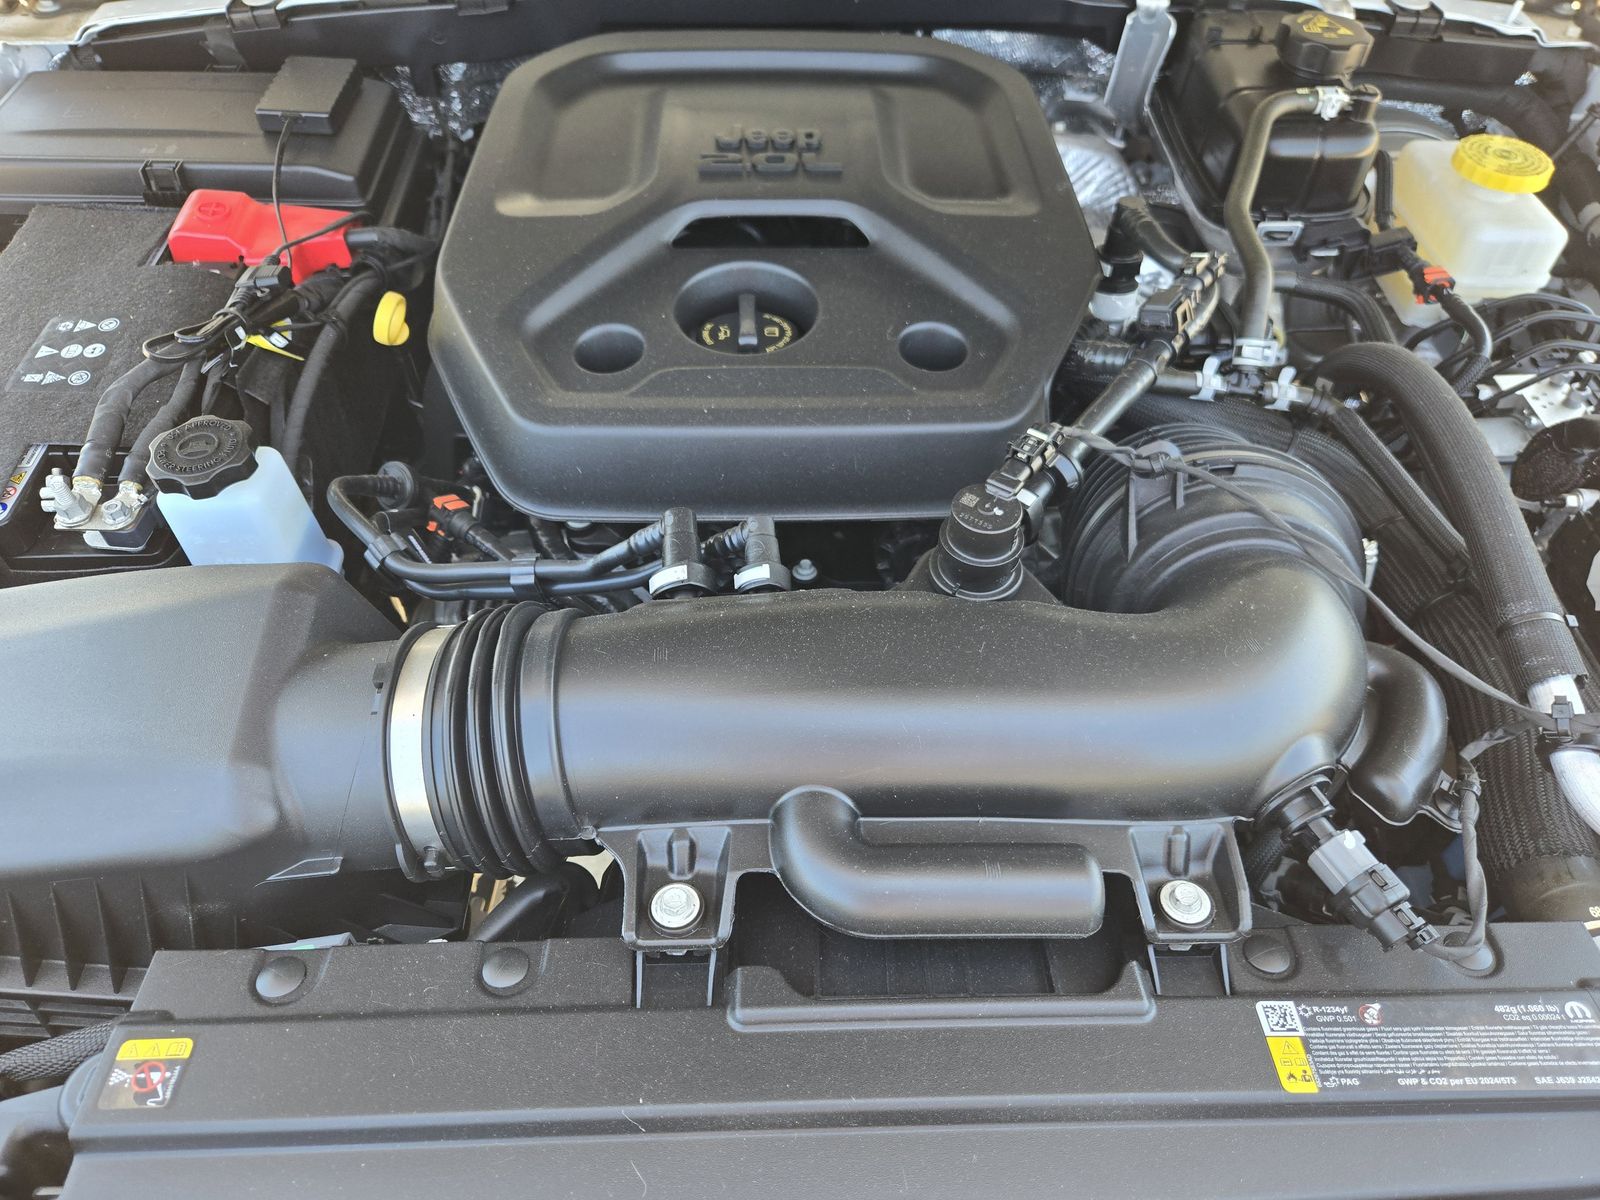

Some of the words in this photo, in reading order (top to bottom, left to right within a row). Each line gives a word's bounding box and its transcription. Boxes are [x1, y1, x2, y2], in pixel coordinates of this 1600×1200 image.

[698, 152, 844, 177] 2.0L
[184, 419, 233, 431] APPROVED
[176, 454, 224, 473] STEERING
[1312, 1005, 1348, 1015] R-1234yf
[1494, 1004, 1517, 1014] 482g
[1336, 1015, 1357, 1023] 0.501
[1502, 1013, 1520, 1021] CO2
[1521, 1014, 1532, 1022] eq
[1340, 1077, 1360, 1086] PAG
[1397, 1078, 1419, 1086] GWP
[1420, 1078, 1428, 1086] &
[1429, 1077, 1449, 1086] CO2
[1449, 1078, 1464, 1087] per
[1464, 1076, 1479, 1085] EU
[1479, 1076, 1517, 1085] 2024/573
[1534, 1076, 1555, 1085] SAE
